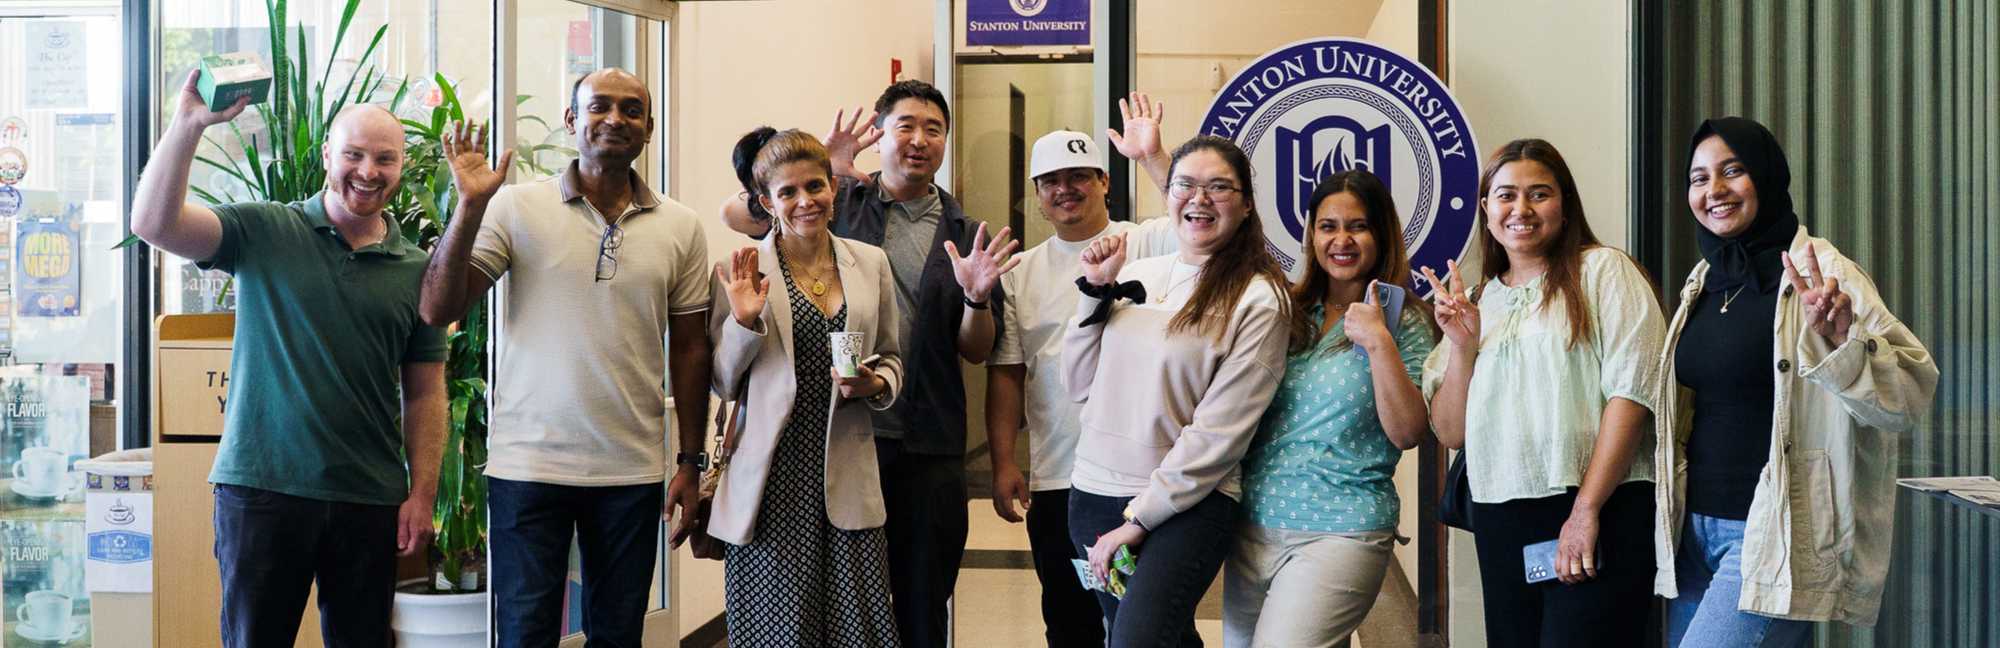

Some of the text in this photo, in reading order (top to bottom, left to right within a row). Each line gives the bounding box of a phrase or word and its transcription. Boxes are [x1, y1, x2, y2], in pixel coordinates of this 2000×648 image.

[969, 20, 1087, 32] STANTON UNIVERSITY
[1209, 46, 1467, 160] TANTON UNIVERSITY
[26, 231, 71, 255] MORE
[26, 255, 71, 278] MEGA
[7, 402, 46, 418] FLAVOR
[10, 546, 49, 561] FLAVOR
